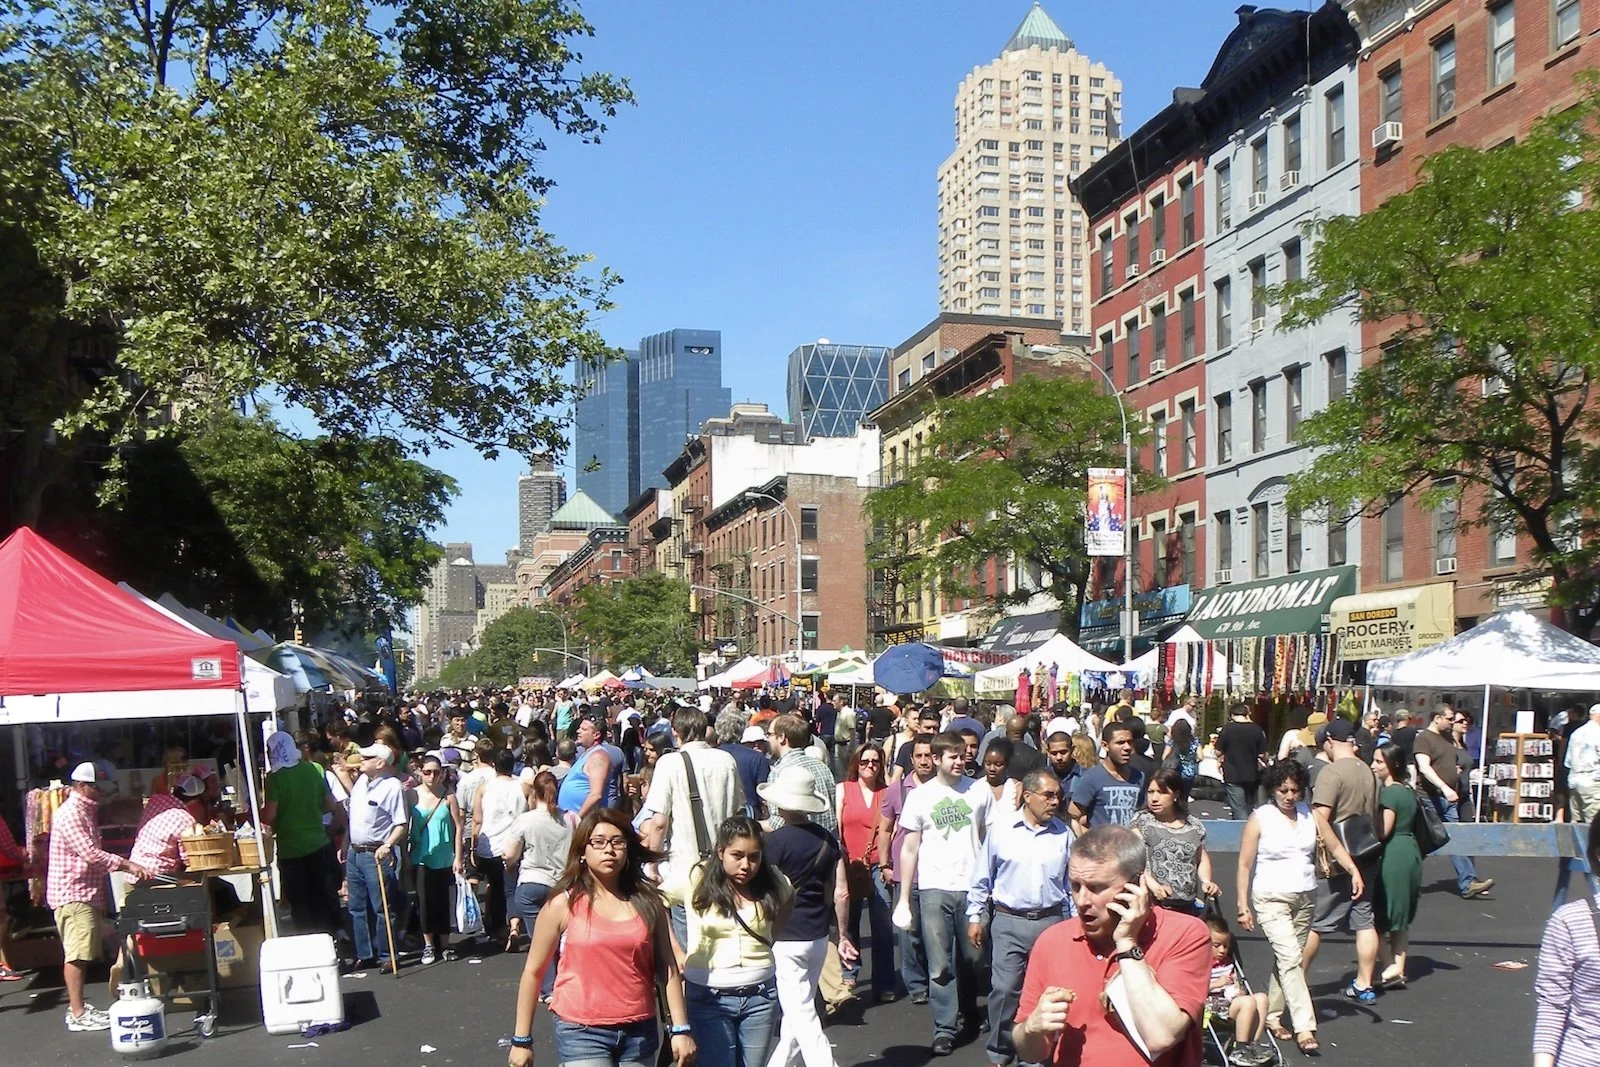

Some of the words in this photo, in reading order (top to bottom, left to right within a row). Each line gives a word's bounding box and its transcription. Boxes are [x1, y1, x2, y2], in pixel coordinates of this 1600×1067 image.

[1185, 574, 1340, 622] LAUNDROMAT
[1350, 611, 1365, 621] SAN
[1335, 620, 1409, 638] GROCERY
[1344, 639, 1368, 650] MEAT
[1370, 636, 1411, 648] MARKET
[940, 805, 959, 816] GET
[936, 812, 967, 825] LUCKY
